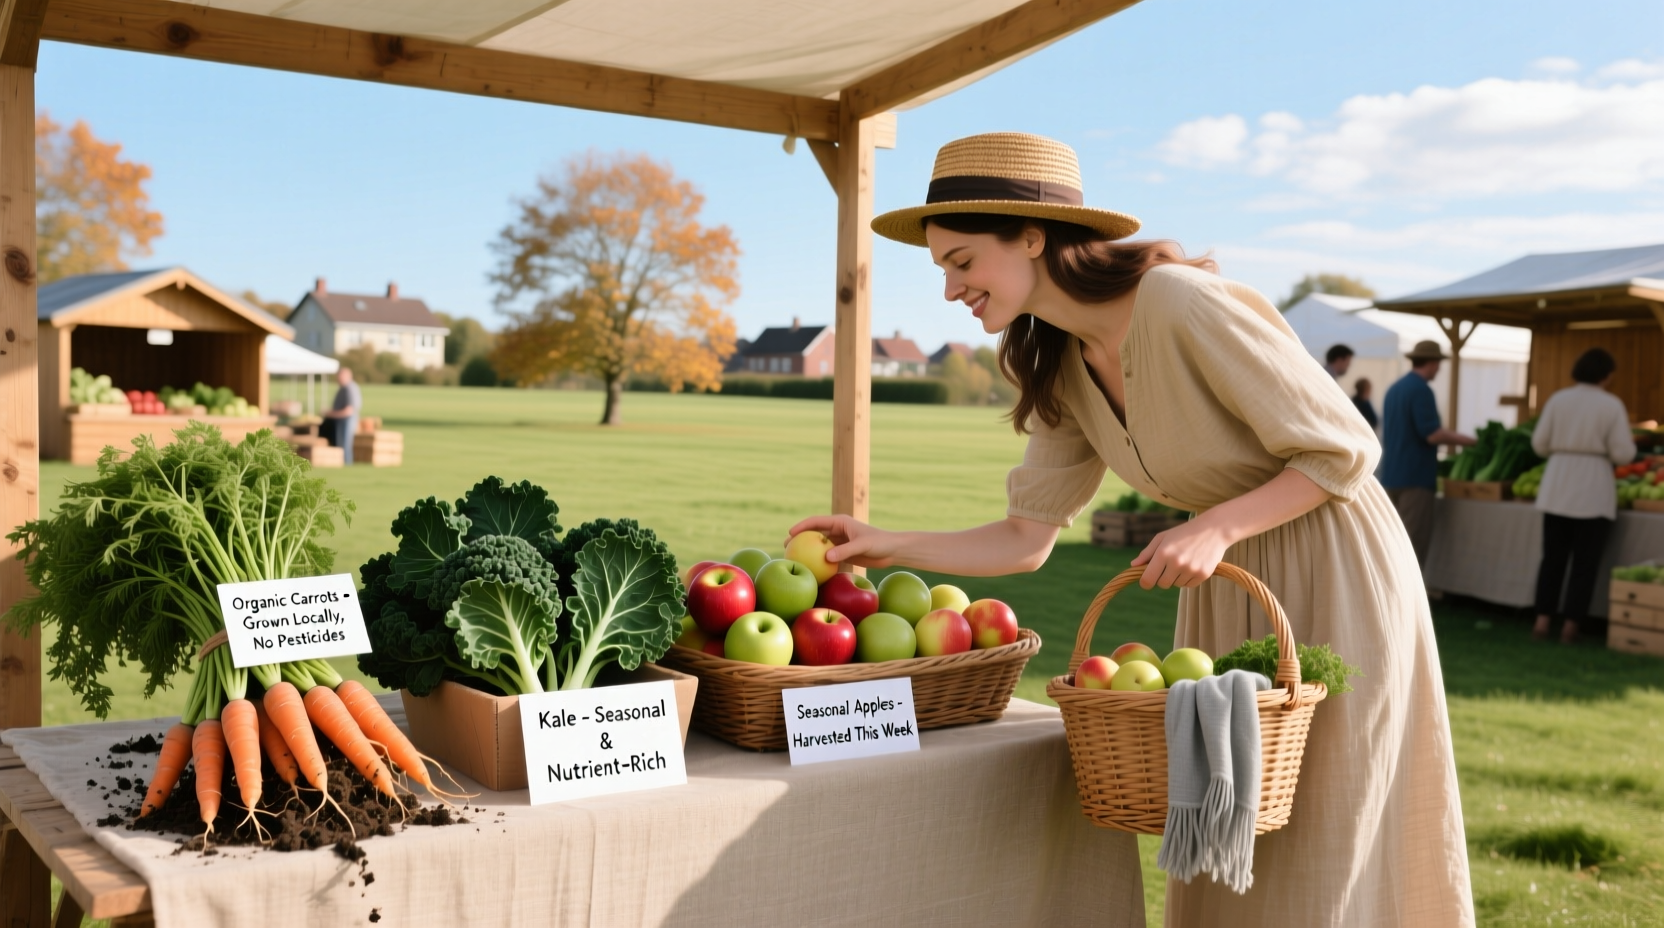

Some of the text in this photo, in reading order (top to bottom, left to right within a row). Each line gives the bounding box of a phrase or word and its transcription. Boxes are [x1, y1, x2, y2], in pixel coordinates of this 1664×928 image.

[232, 593, 287, 614] Organic
[290, 591, 339, 605] Carrots
[243, 608, 345, 630] Grown Locally,
[253, 629, 345, 650] No Pesticides
[538, 709, 577, 729] Kale
[594, 699, 666, 724] Seasonal
[797, 700, 850, 720] Seasonal
[854, 696, 895, 719] Apples
[600, 732, 613, 750] &
[793, 720, 914, 748] Harvested This Week
[547, 750, 666, 783] Nutrient-Rich
